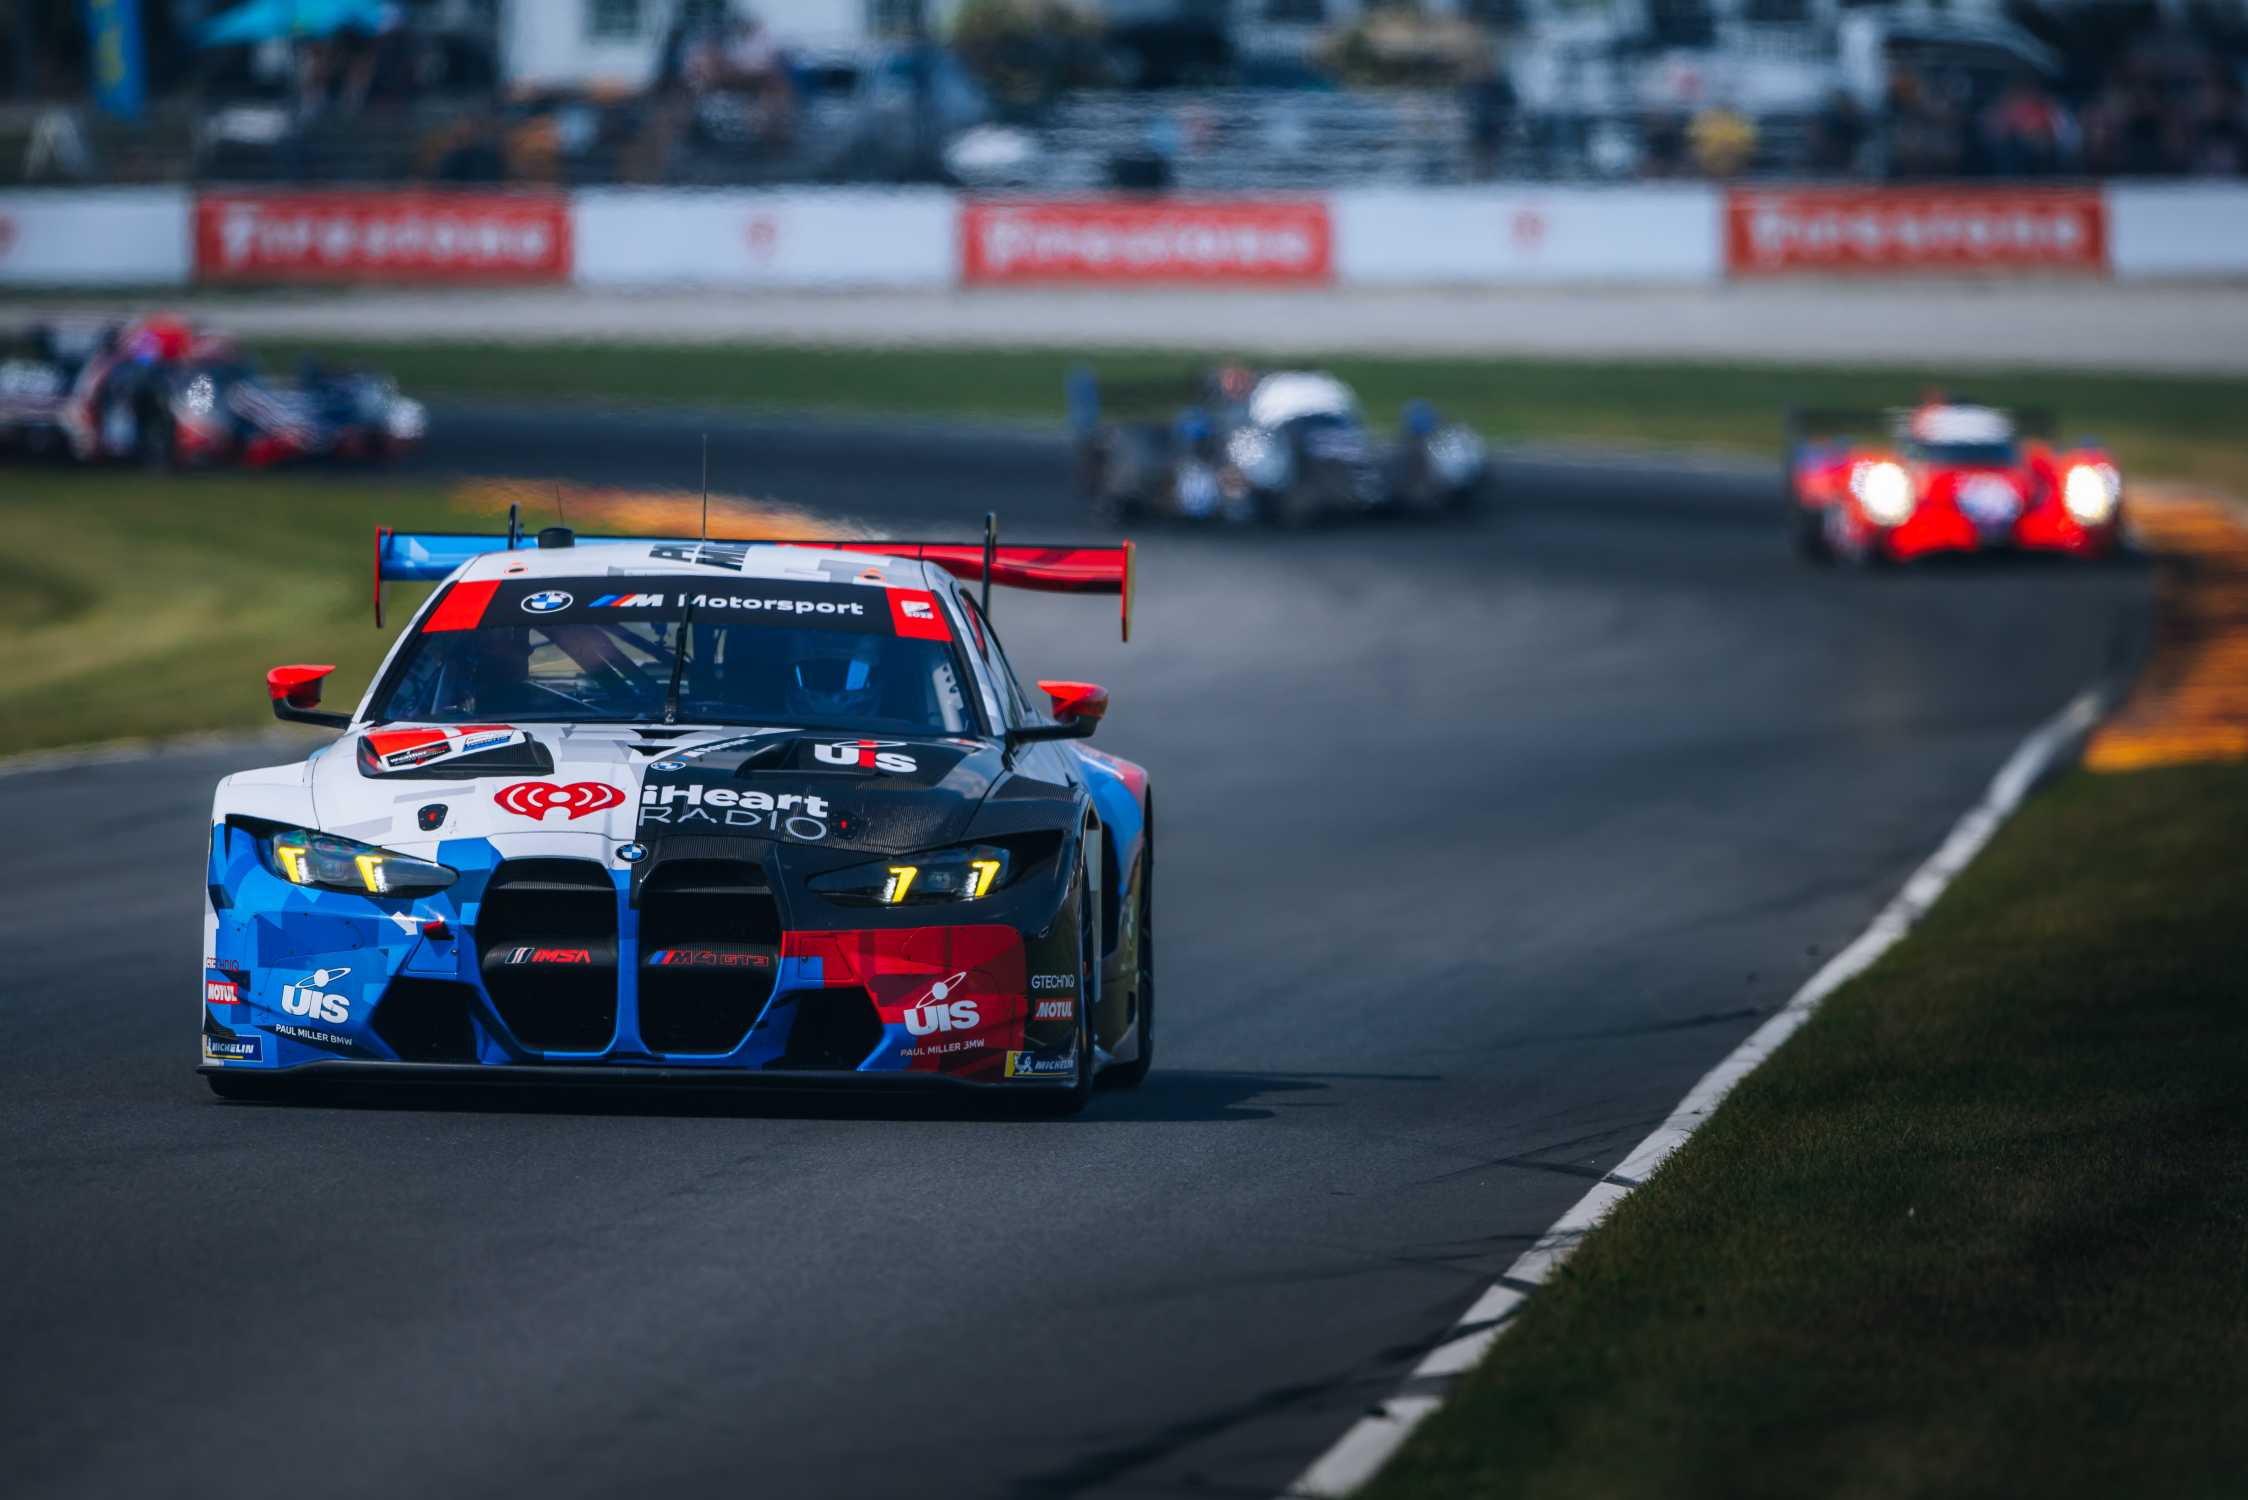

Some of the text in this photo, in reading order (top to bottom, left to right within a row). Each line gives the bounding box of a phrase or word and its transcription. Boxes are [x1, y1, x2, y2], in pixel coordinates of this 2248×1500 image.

[677, 593, 865, 616] Motorsport
[641, 784, 829, 818] iHeart
[638, 806, 828, 841] RADIO
[531, 949, 592, 965] IMSA
[207, 983, 238, 1002] MOTUL
[1035, 1000, 1073, 1018] MOTUL
[275, 1023, 353, 1046] PAUL MILLER BMW
[900, 1047, 926, 1057] PAUL
[927, 1042, 961, 1056] MILLER
